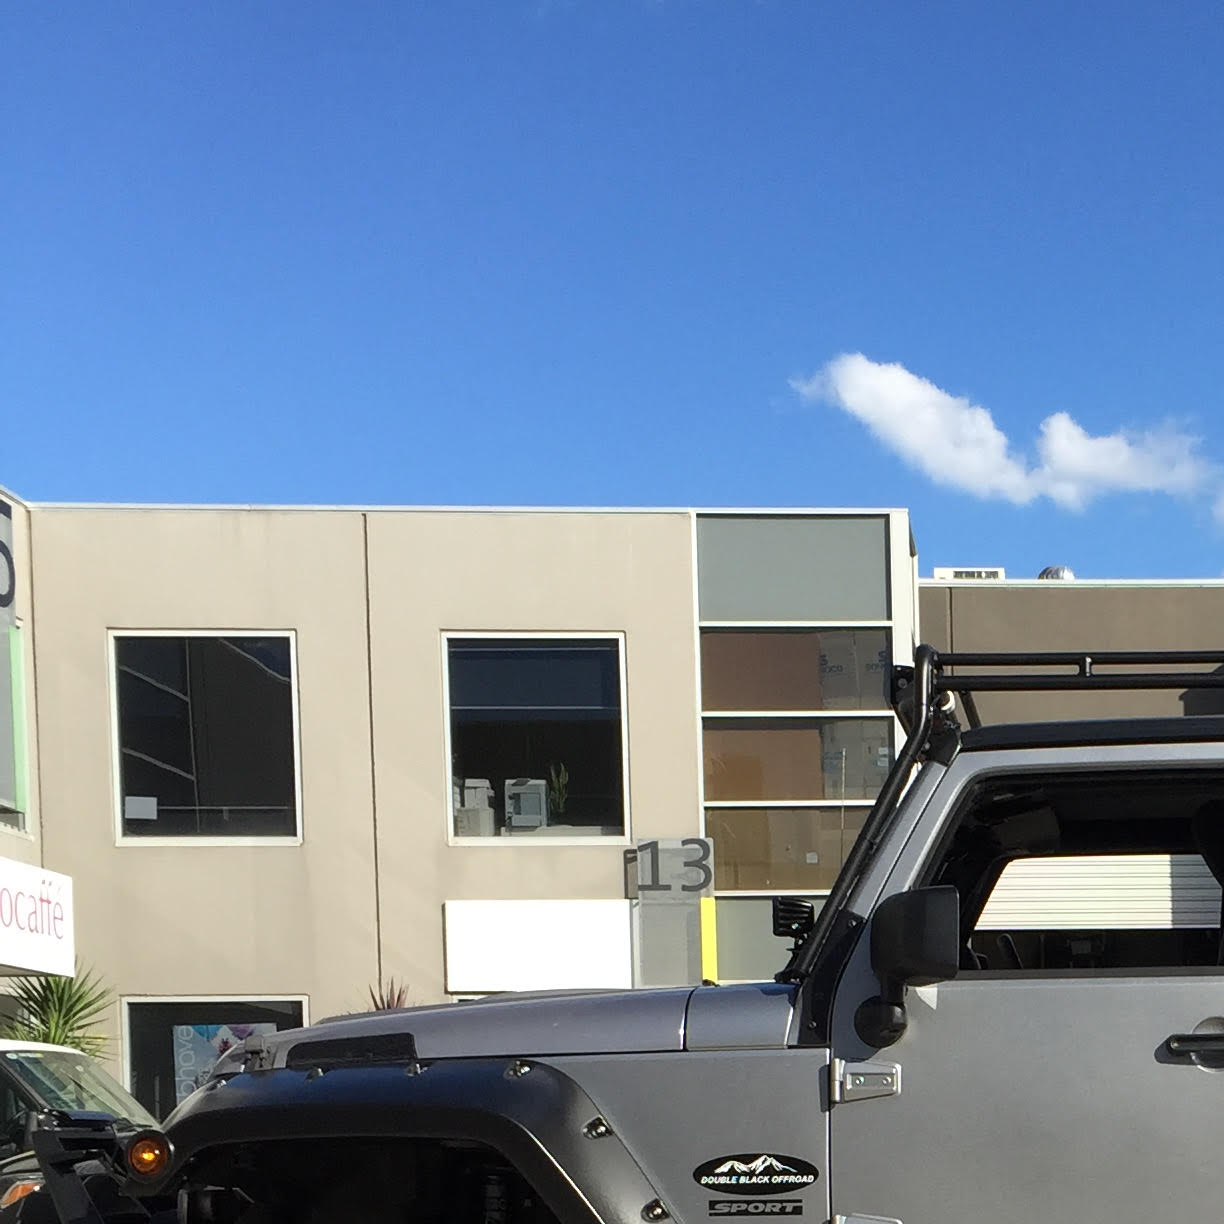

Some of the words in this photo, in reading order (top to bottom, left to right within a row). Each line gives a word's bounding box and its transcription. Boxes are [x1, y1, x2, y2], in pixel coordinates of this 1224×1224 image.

[637, 838, 712, 892] 13
[701, 1175, 738, 1184] DOUBLE
[739, 1175, 770, 1184] BLACK
[771, 1175, 815, 1183] OFFROAD
[709, 1202, 802, 1213] SPORT
